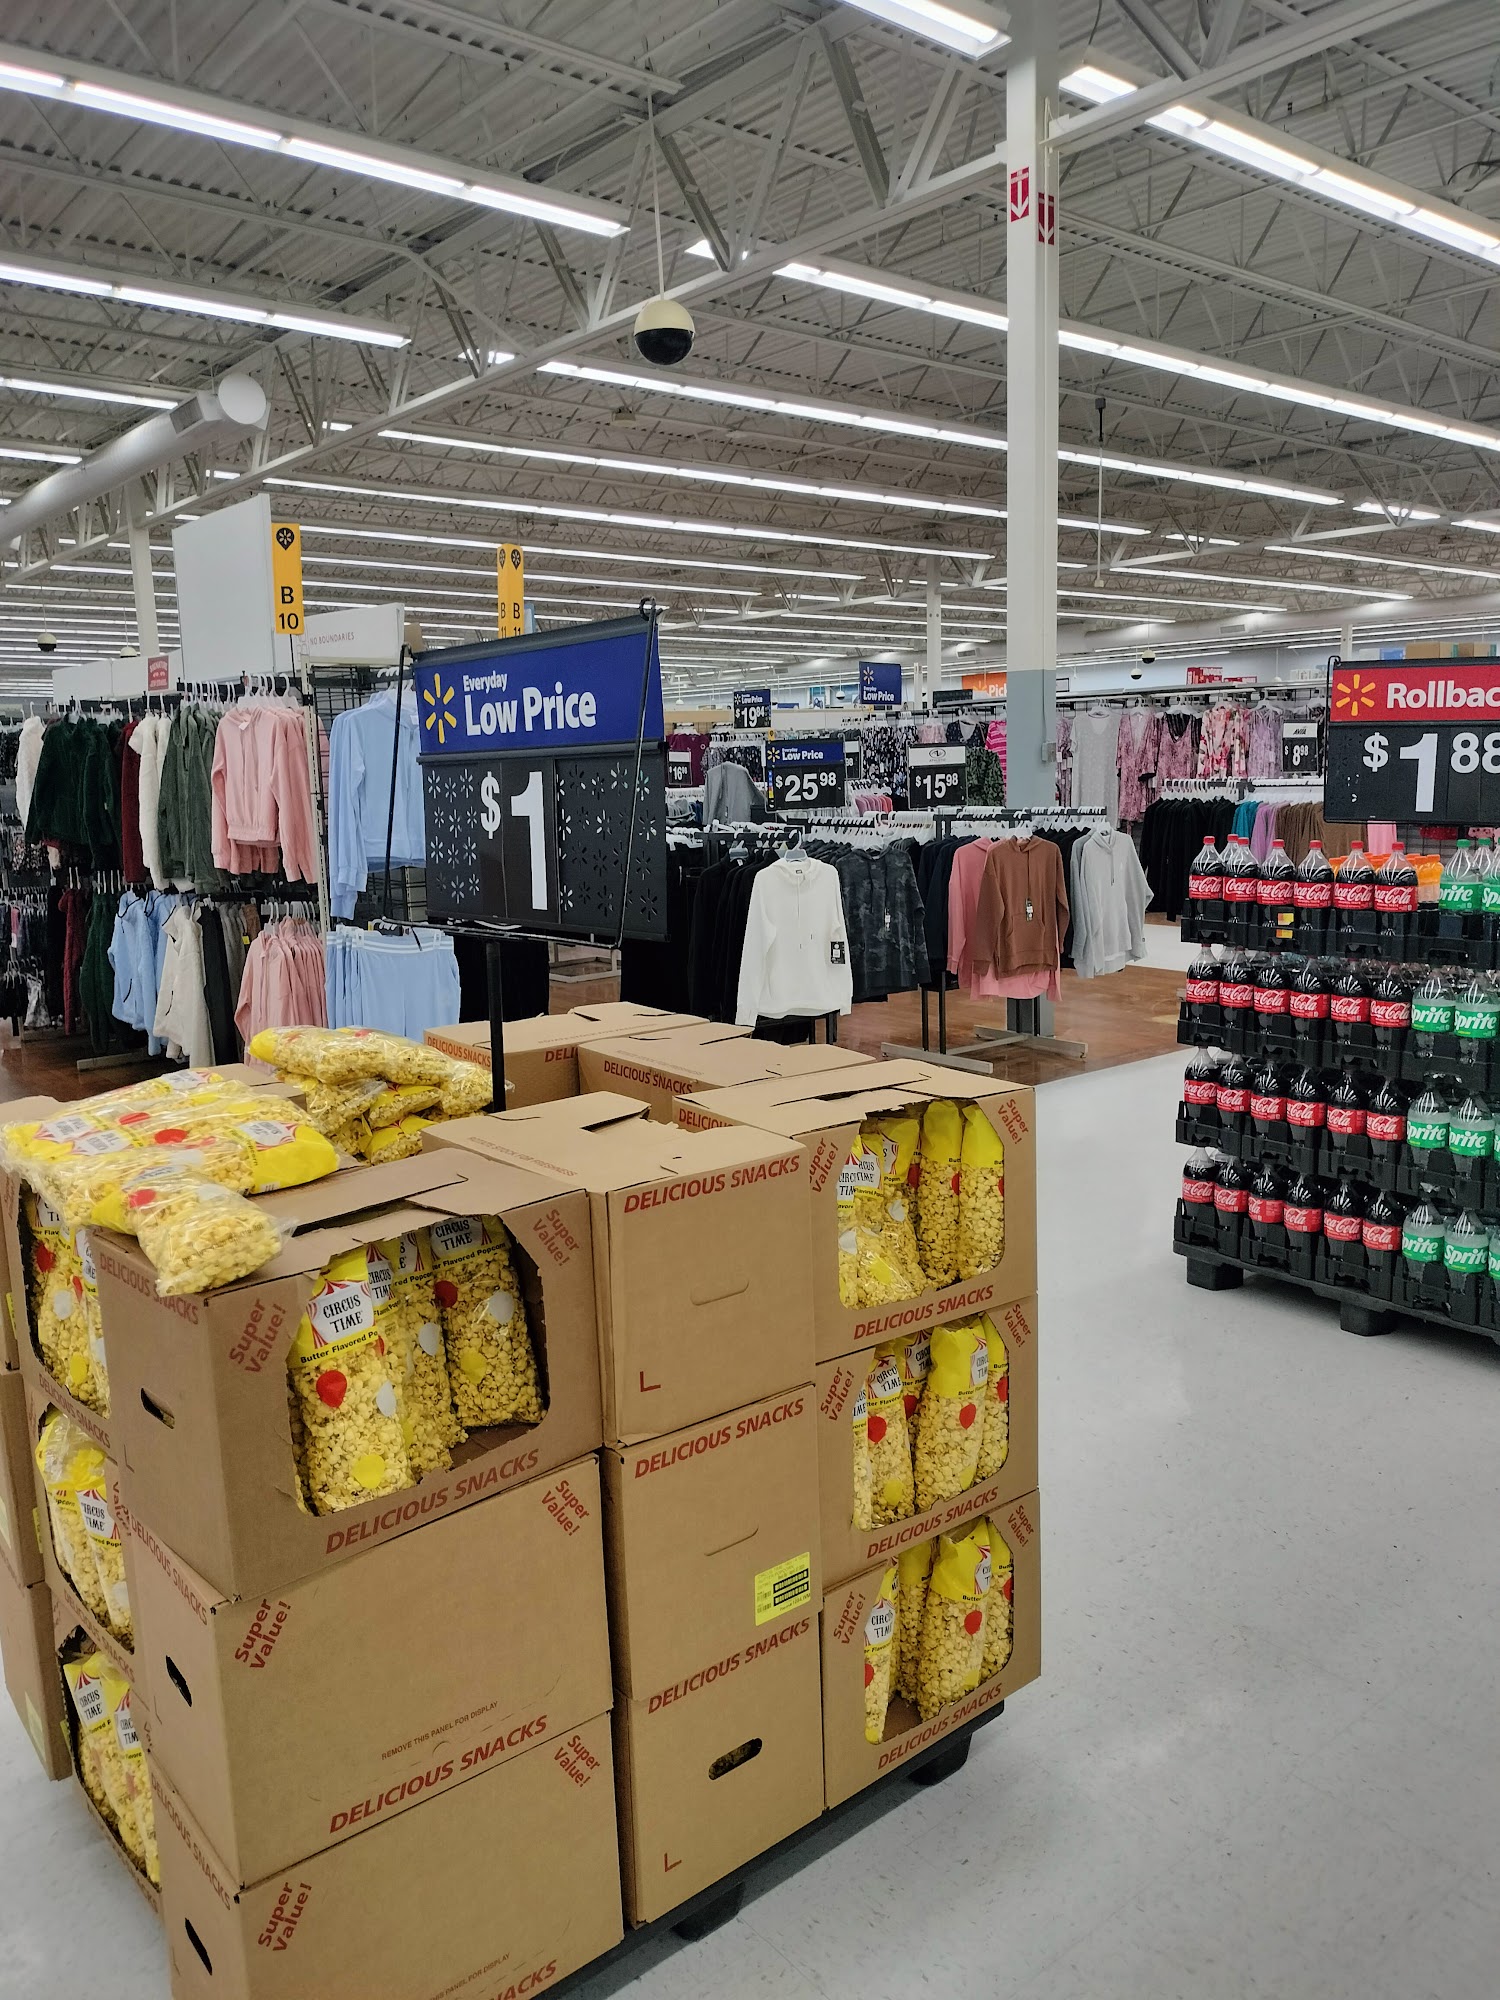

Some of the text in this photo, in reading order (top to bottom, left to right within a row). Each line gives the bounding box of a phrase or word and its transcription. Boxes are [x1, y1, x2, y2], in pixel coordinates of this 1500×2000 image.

[280, 586, 294, 604] B
[500, 602, 506, 619] B
[513, 602, 521, 619] B
[278, 613, 299, 630] 10
[309, 632, 355, 646] NO BOUNDARIES
[462, 670, 508, 692] Everyday
[864, 691, 894, 701] Low Price
[464, 682, 596, 736] Low Price
[782, 750, 823, 760] Low Price
[428, 1036, 490, 1067] DELICIOUS SNACKS
[604, 1061, 651, 1084] DELICIOUS
[652, 1074, 693, 1094] SNACKS
[997, 1104, 1022, 1145] Value!
[1006, 1099, 1029, 1134] Super
[624, 1155, 799, 1213] DELICIOUS SNACKS
[812, 1142, 838, 1192] Value!
[47, 1212, 59, 1221] TI
[435, 1220, 470, 1238] CIRCUS
[546, 1208, 580, 1253] Super
[441, 1233, 472, 1250] TIME
[443, 1252, 475, 1267] Flavored
[477, 1242, 506, 1256] Popcorn
[532, 1218, 571, 1267] Value!
[100, 1252, 150, 1297] DELICIOUS
[323, 1294, 361, 1319] CIRCUS
[330, 1312, 362, 1333] TIME
[854, 1285, 994, 1340] DELICIOUS SNACKS
[1012, 1303, 1031, 1336] Super
[229, 1298, 262, 1365] Super
[244, 1302, 287, 1375] Value!
[300, 1350, 330, 1364] Butter
[332, 1334, 366, 1353] Flavored
[1004, 1312, 1025, 1348] Value!
[820, 1367, 844, 1413] Super
[877, 1364, 897, 1384] CIRCU
[829, 1370, 855, 1421] Value!
[635, 1398, 804, 1479] DELICIOUS SNACKS
[325, 1449, 539, 1554] DELICIOUS SNACKS
[541, 1490, 581, 1537] Value!
[555, 1479, 590, 1520] Super
[1015, 1504, 1034, 1535] Super
[867, 1487, 998, 1559] DELICIOUS SNACKS
[1007, 1513, 1027, 1548] Value!
[131, 1514, 207, 1626] DELICIOUS SNACKS
[234, 1598, 272, 1663] Super
[249, 1600, 292, 1670] Value!
[833, 1591, 856, 1639] Super
[841, 1593, 866, 1645] Value!
[648, 1618, 810, 1714] DELICIOUS SNACKS
[120, 1718, 134, 1730] CIRC
[124, 1732, 138, 1744] TIM
[381, 1700, 498, 1760] REMOVE THIS PANEL FOR DISPLAY
[878, 1683, 1002, 1770] DELICIOUS SNACKS
[553, 1747, 592, 1788] Value!
[566, 1734, 601, 1772] Super
[329, 1715, 548, 1833] DELICIOUS SNACKS
[194, 1842, 230, 1911] SNACKS
[257, 1881, 293, 1949] Super
[272, 1882, 312, 1953] Value!
[446, 1952, 510, 1995] PANEL FOR DISPLAY
